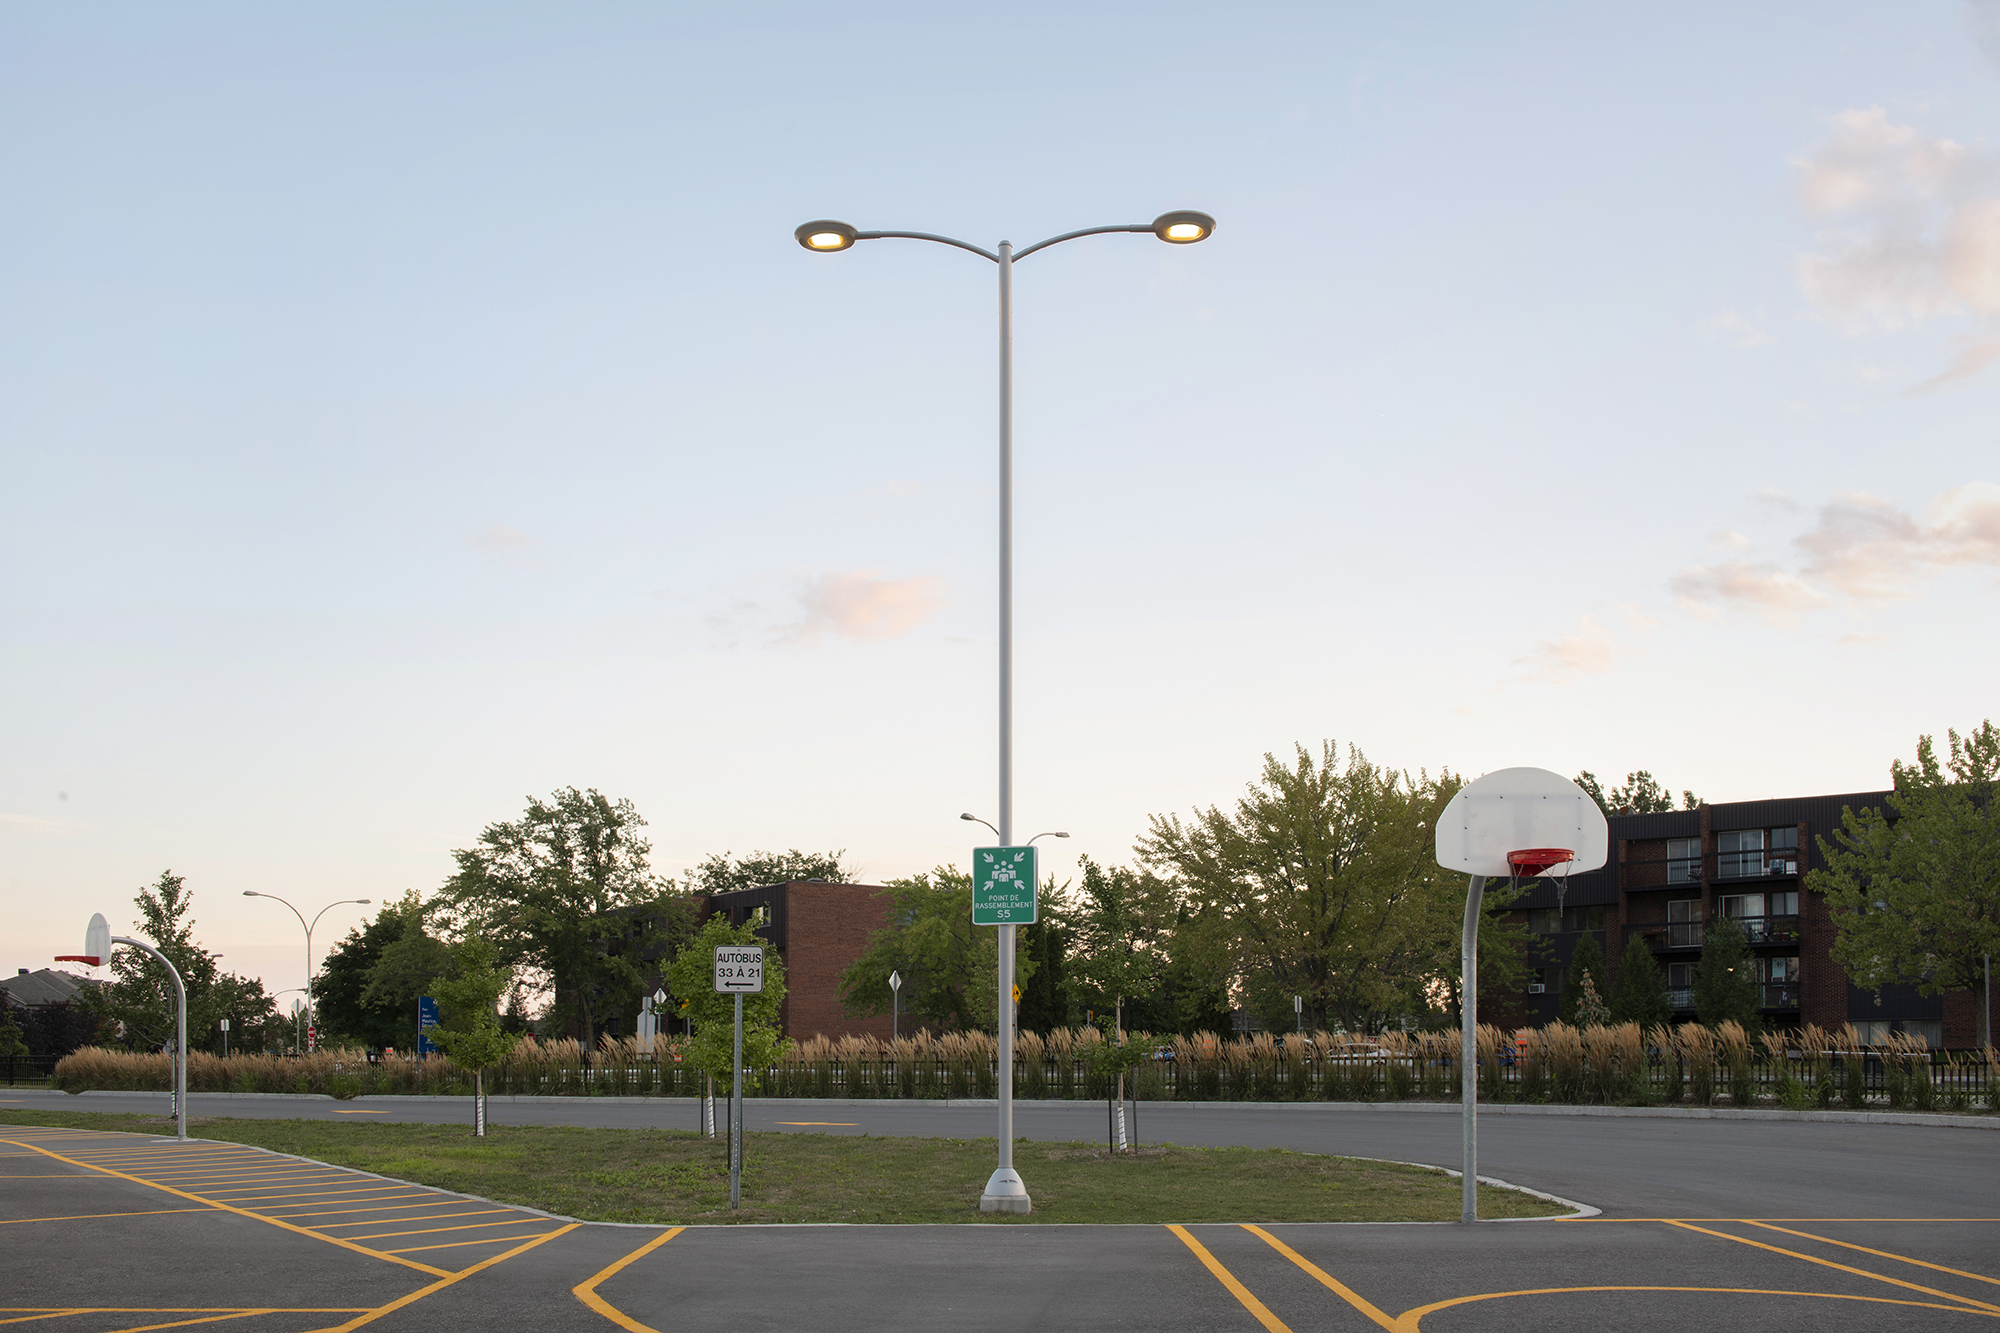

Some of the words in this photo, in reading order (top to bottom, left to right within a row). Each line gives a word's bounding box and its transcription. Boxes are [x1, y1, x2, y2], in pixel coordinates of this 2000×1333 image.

[997, 910, 1011, 918] S5
[717, 953, 762, 963] AUTOBUS
[718, 968, 733, 978] 33
[736, 966, 744, 978] À
[748, 968, 760, 978] 21
